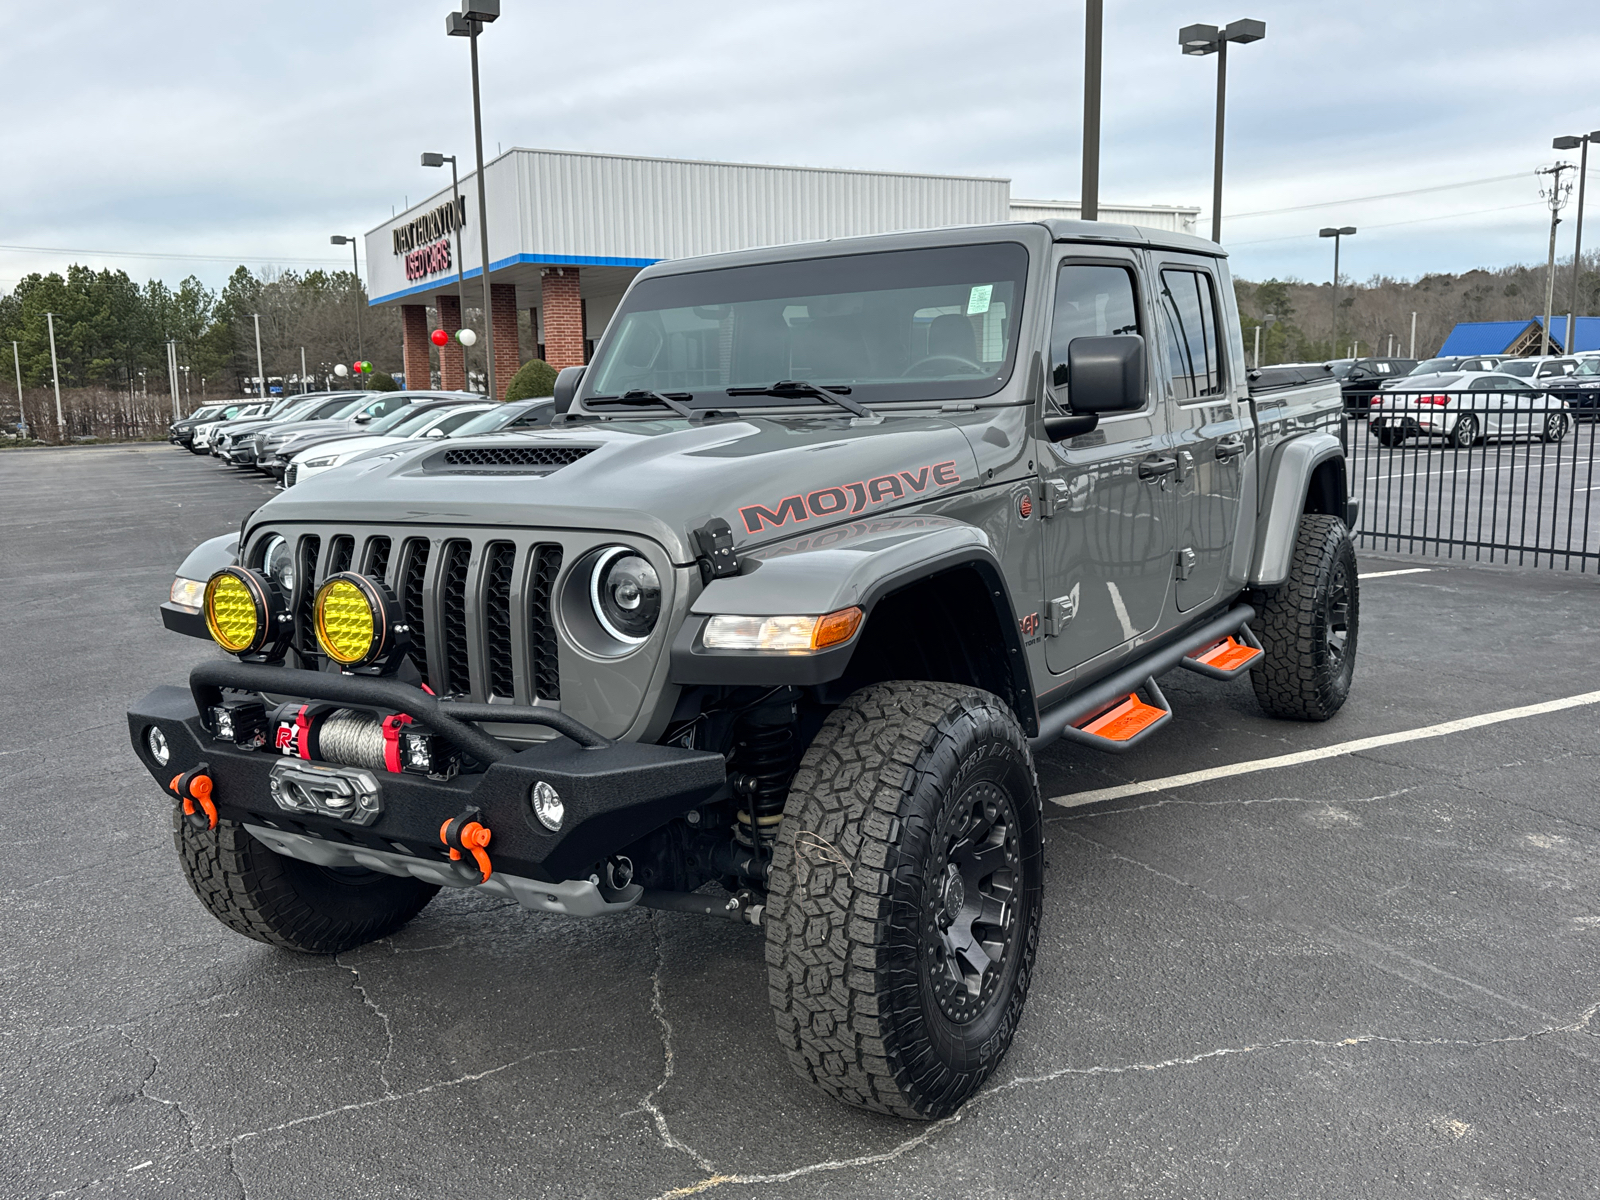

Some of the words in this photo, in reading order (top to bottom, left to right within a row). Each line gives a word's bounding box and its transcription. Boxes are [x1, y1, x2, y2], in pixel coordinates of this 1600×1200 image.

[392, 223, 414, 255] JOHN
[405, 250, 427, 280] USED
[425, 239, 452, 273] CARS
[738, 460, 960, 534] MOJAVE
